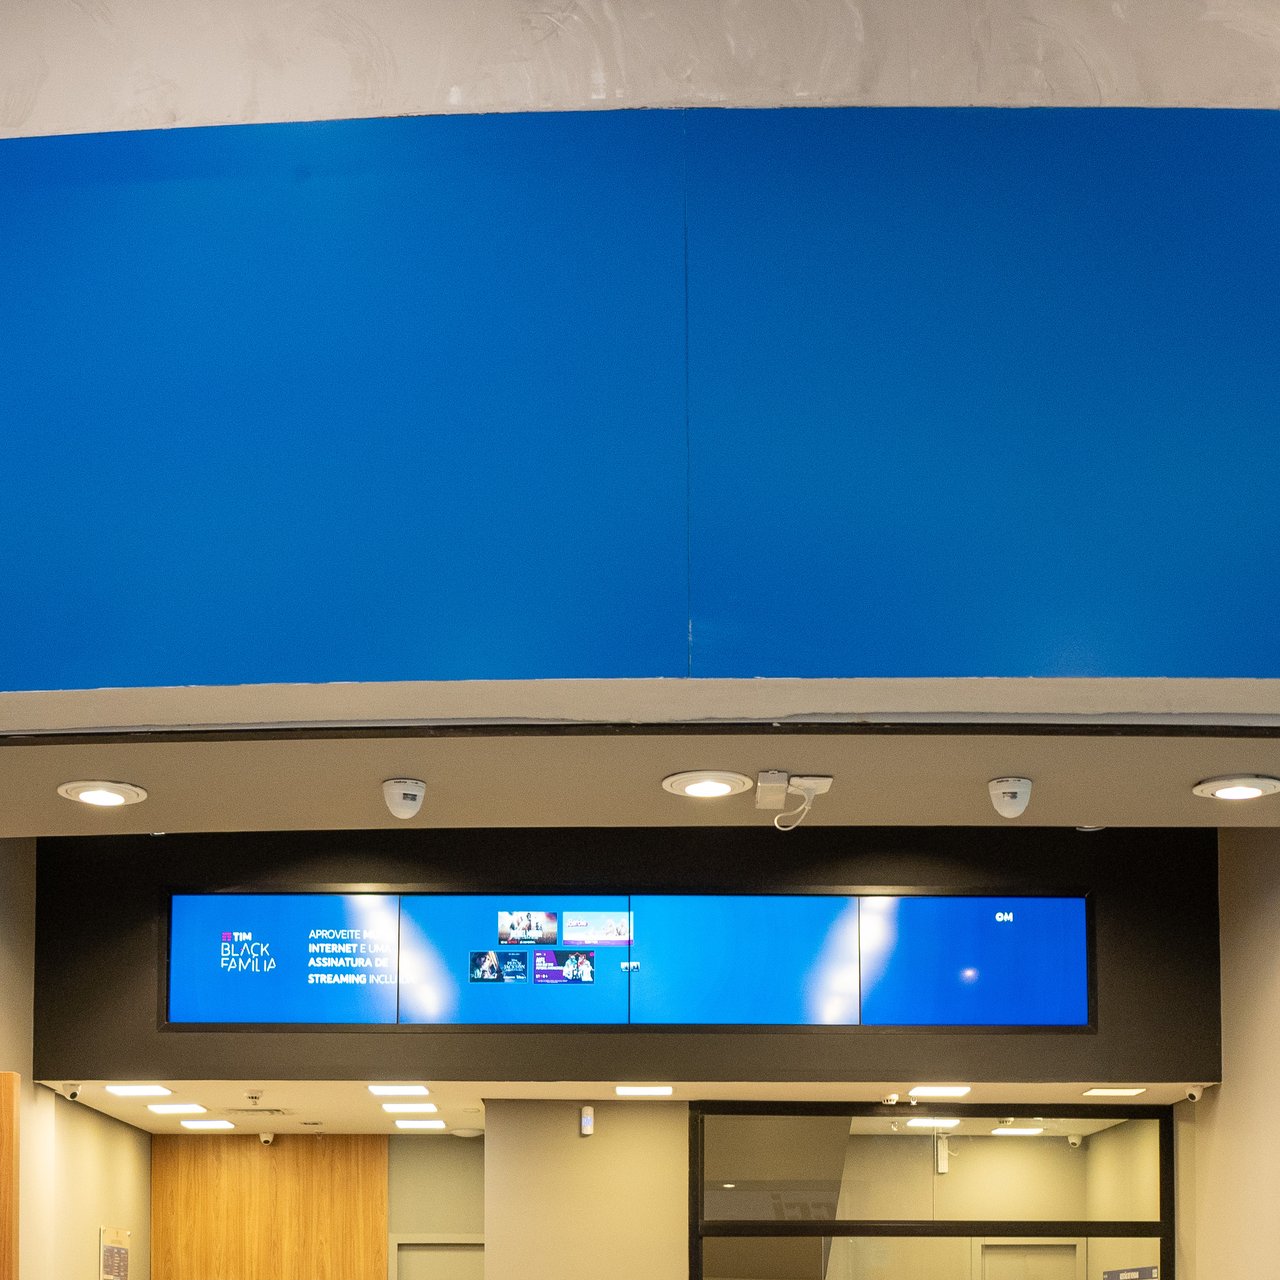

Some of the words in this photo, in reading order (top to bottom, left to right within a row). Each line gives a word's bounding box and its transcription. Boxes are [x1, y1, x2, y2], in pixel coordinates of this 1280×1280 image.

[233, 932, 252, 941] TIM
[308, 929, 361, 940] APROVEITE
[221, 943, 270, 957] BLACK
[308, 943, 358, 953] INTERNET
[360, 943, 367, 953] E
[221, 954, 277, 972] FAMÍLIA
[308, 957, 372, 968] ASSINATURA
[308, 973, 367, 984] STREAMING
